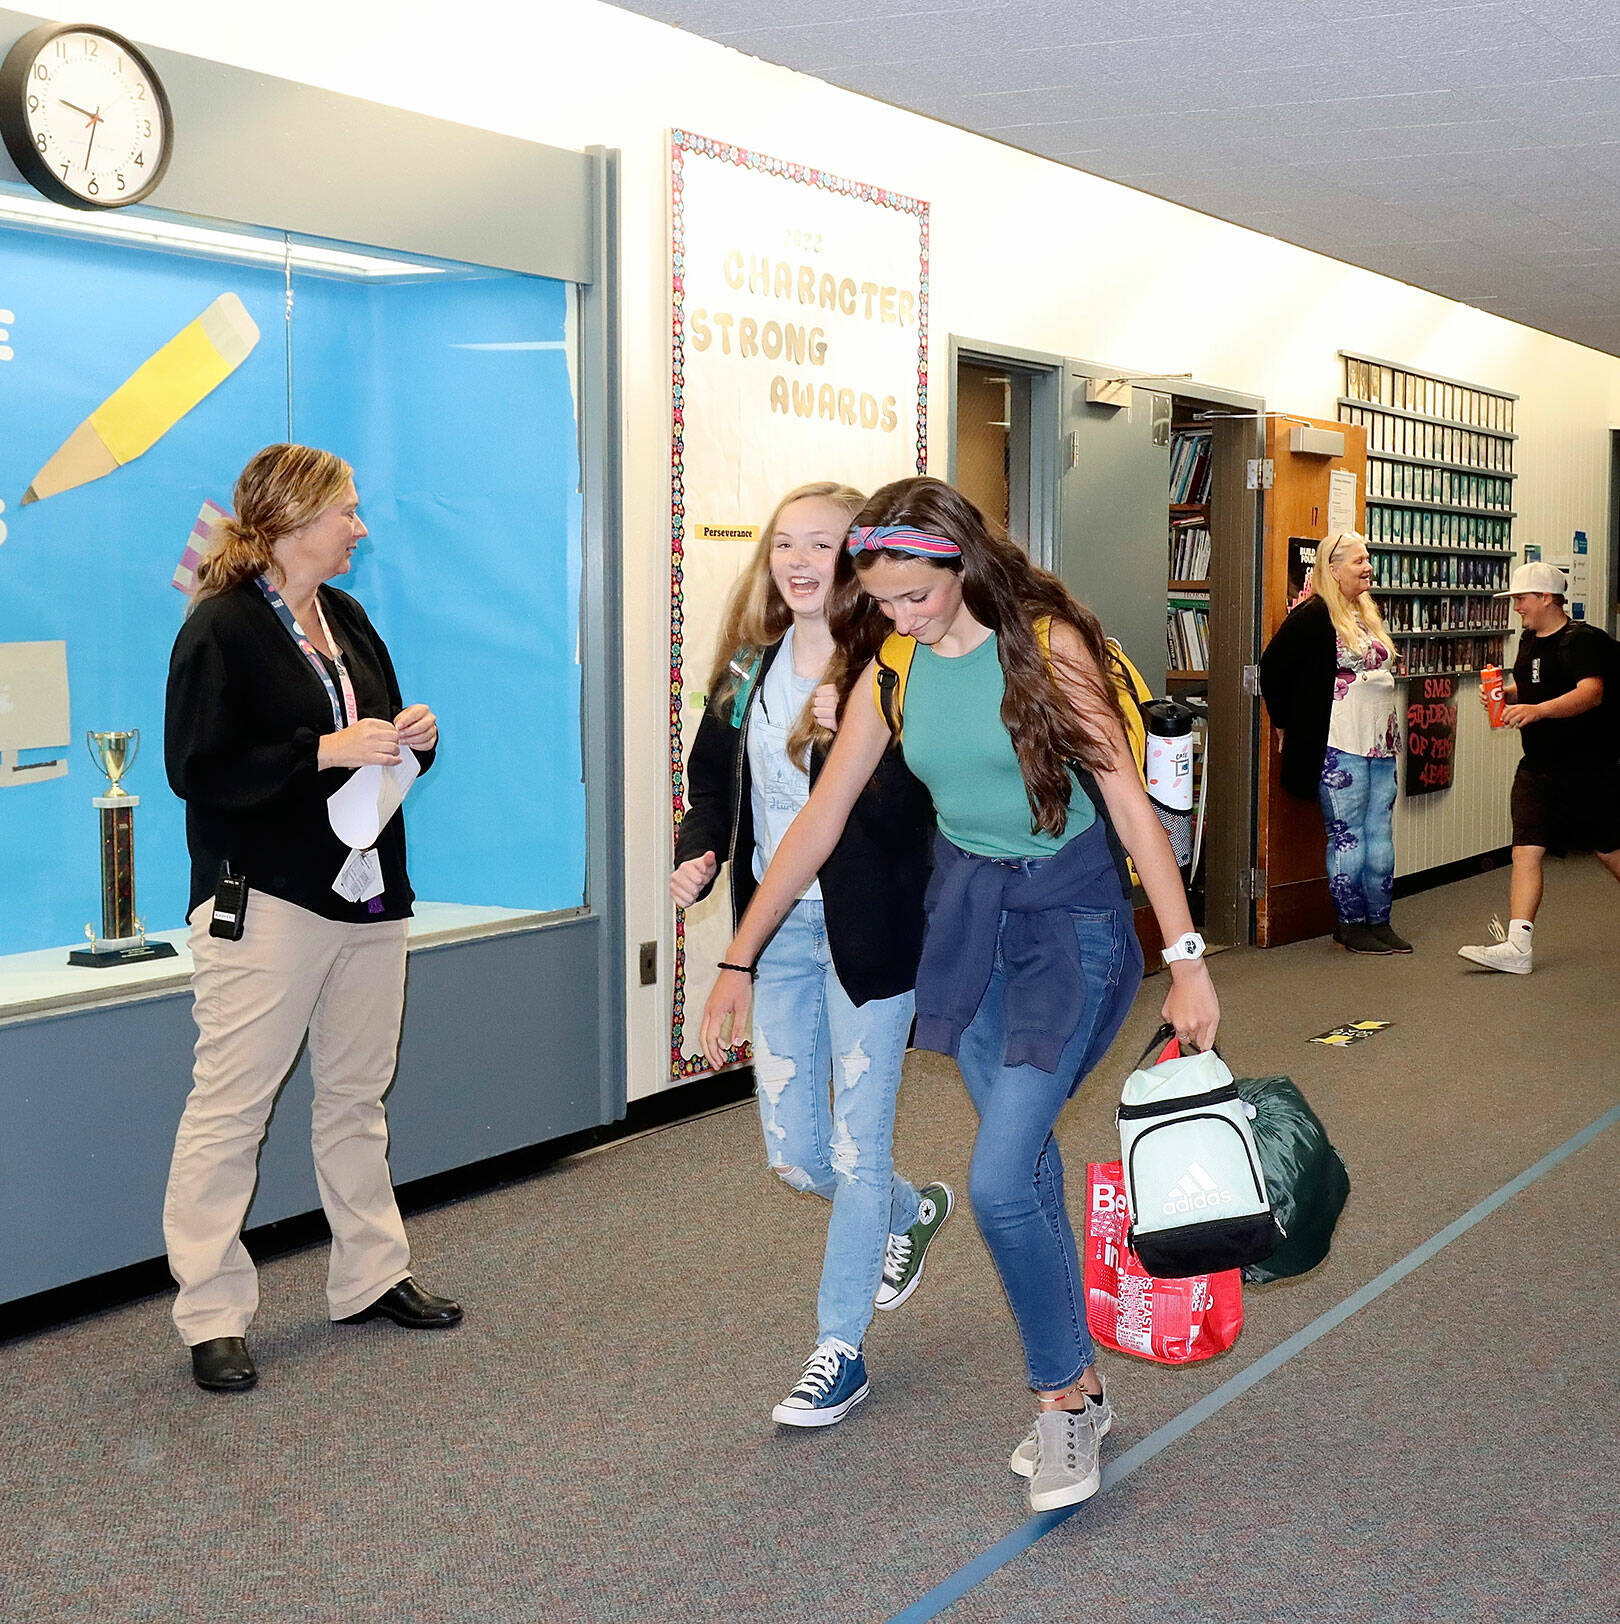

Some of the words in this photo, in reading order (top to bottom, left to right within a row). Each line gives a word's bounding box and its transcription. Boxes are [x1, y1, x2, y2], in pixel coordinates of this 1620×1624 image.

[56, 41, 66, 59] 11
[84, 39, 99, 57] 12
[33, 63, 48, 81] 10
[118, 57, 122, 73] 1
[136, 83, 145, 101] 2
[28, 95, 39, 114] 9
[143, 120, 152, 138] 3
[37, 133, 47, 153] 8
[134, 152, 144, 168] 4
[60, 164, 69, 181] 7
[88, 177, 99, 195] 6
[117, 174, 126, 191] 5
[784, 229, 823, 253] 2022
[723, 249, 915, 327] CHARACTER
[691, 308, 828, 366] STRONG
[770, 375, 898, 433] AWARDS
[1311, 506, 1319, 527] 17
[703, 526, 753, 538] Perseverance
[1423, 678, 1452, 699] SMS
[1409, 733, 1428, 756] OF
[1162, 1190, 1232, 1216] adidas
